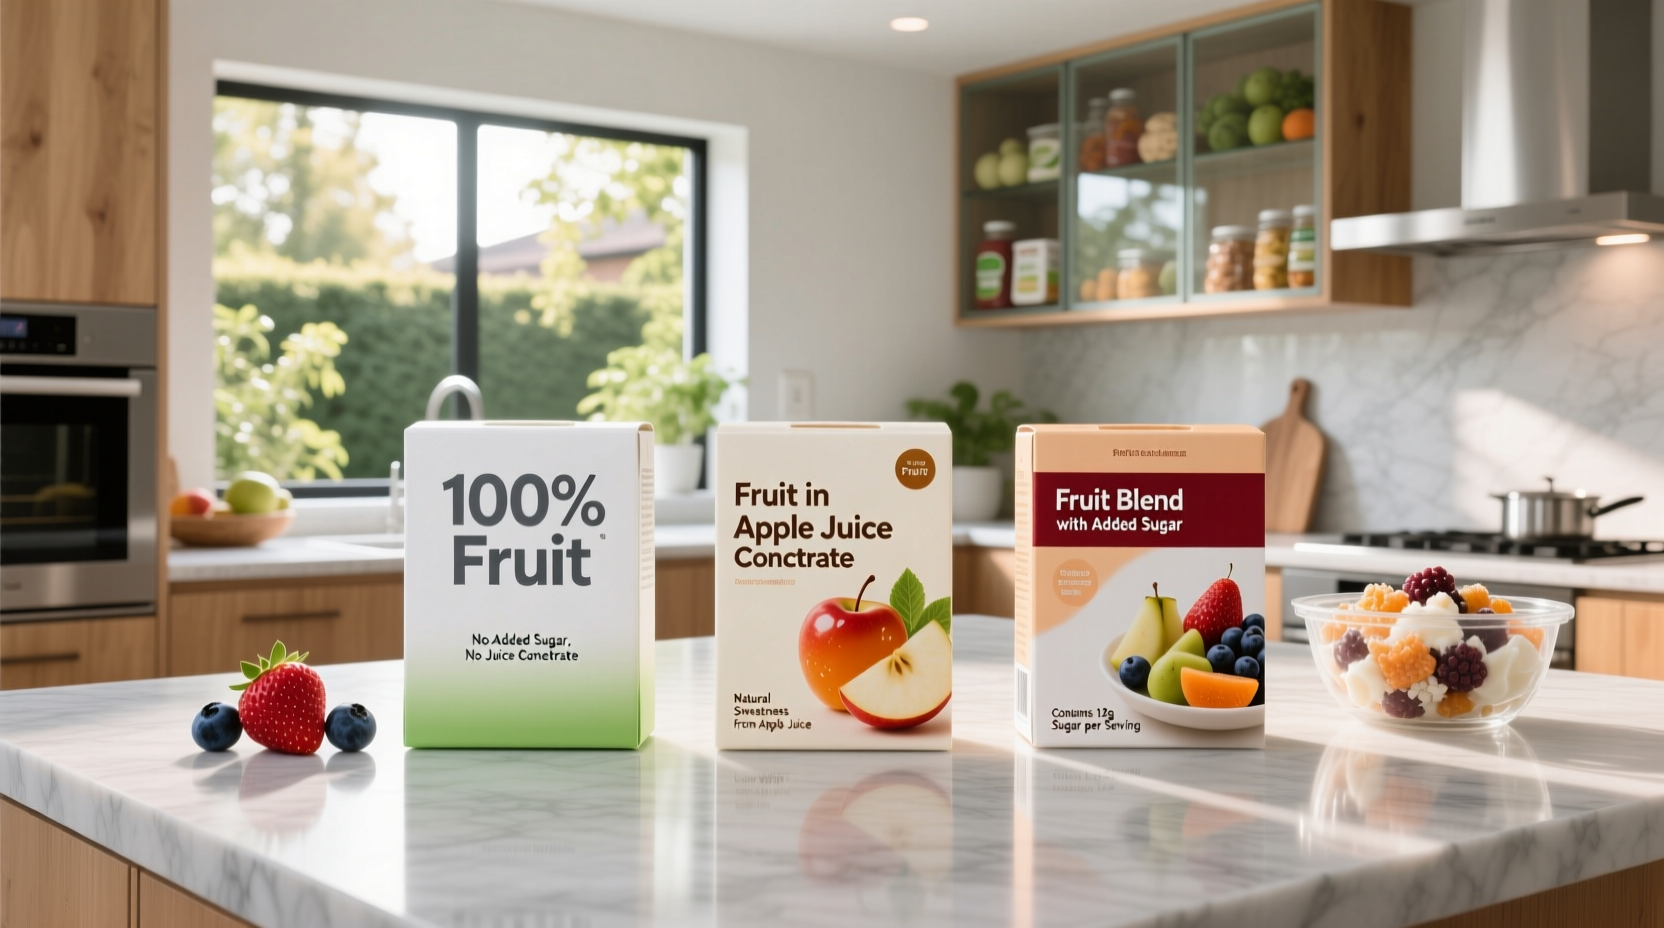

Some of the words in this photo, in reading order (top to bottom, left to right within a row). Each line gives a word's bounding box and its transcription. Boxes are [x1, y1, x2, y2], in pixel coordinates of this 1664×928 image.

[442, 473, 606, 527] 100%
[735, 481, 798, 507] Fruit
[806, 481, 829, 507] in
[1056, 488, 1110, 511] Fruit
[1117, 488, 1184, 511] Blend
[733, 514, 814, 546] Apple
[820, 514, 893, 539] Juice
[1056, 517, 1088, 531] with
[1091, 516, 1137, 531] Added
[1141, 516, 1183, 535] Sugar
[453, 533, 592, 587] Fruit
[734, 546, 854, 568] Conctrate
[472, 633, 490, 646] No
[491, 633, 530, 646] Added
[534, 633, 571, 648] Sugar,
[465, 648, 482, 661] No
[485, 648, 515, 661] Juice
[733, 692, 771, 704] Natural
[1096, 708, 1115, 721] 12g
[787, 719, 812, 730] Juice
[1051, 720, 1081, 734] Sugar
[1084, 722, 1102, 734] per
